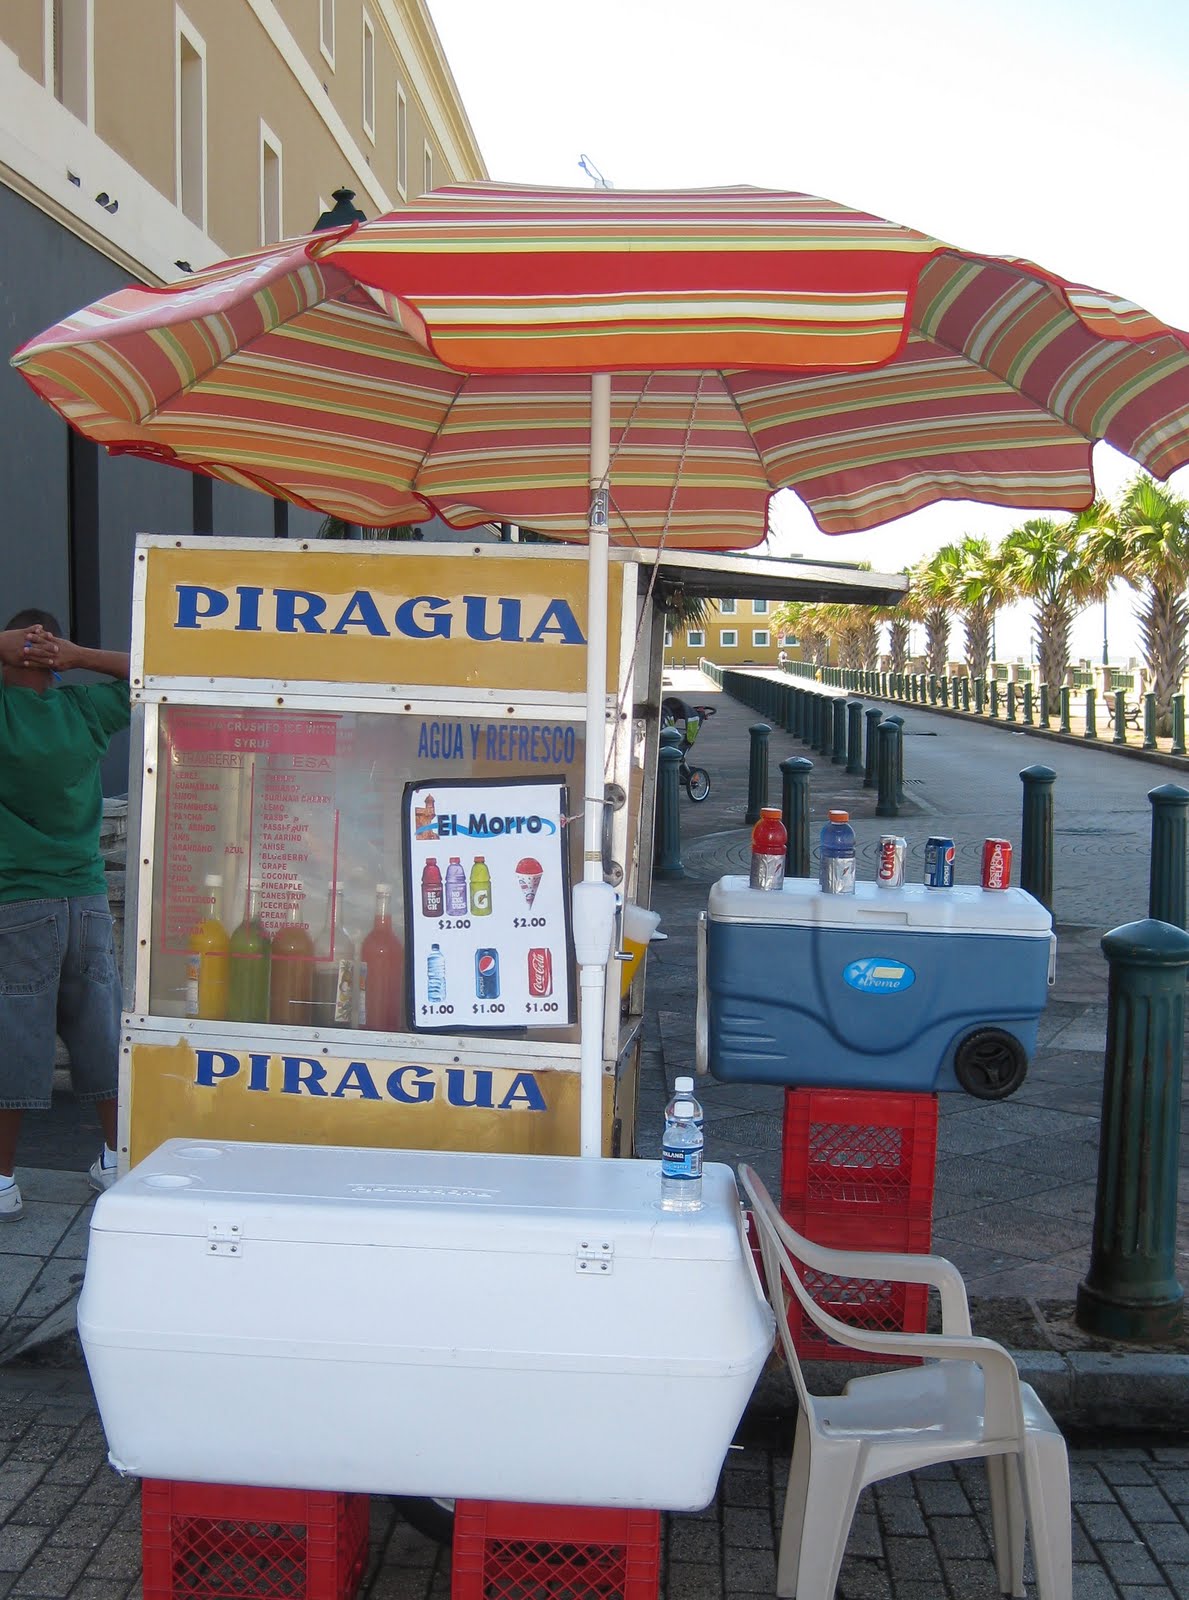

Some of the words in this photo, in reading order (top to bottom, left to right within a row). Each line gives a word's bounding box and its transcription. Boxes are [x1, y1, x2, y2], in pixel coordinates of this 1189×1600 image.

[174, 585, 588, 645] PIRAGUA
[418, 722, 464, 760] AGUA
[470, 723, 480, 760] Y
[486, 724, 575, 764] REFRESCO
[437, 814, 457, 836] El
[469, 813, 542, 835] Morro
[224, 846, 244, 854] AZUL
[262, 843, 285, 851] ANISE
[261, 862, 287, 870] GRAPE
[879, 843, 896, 880] Coke
[261, 882, 302, 890] PINEAPPLE
[261, 892, 306, 901] CANESYRUP
[473, 890, 488, 909] G
[260, 902, 299, 910] ICECREAM
[260, 911, 287, 919] CREAM
[438, 919, 471, 930] $2.00
[513, 917, 546, 928] $2.00
[422, 1005, 454, 1015] $1.00
[472, 1003, 505, 1014] $1.00
[525, 1002, 558, 1013] $1.00
[195, 1049, 548, 1111] PIRAGUA
